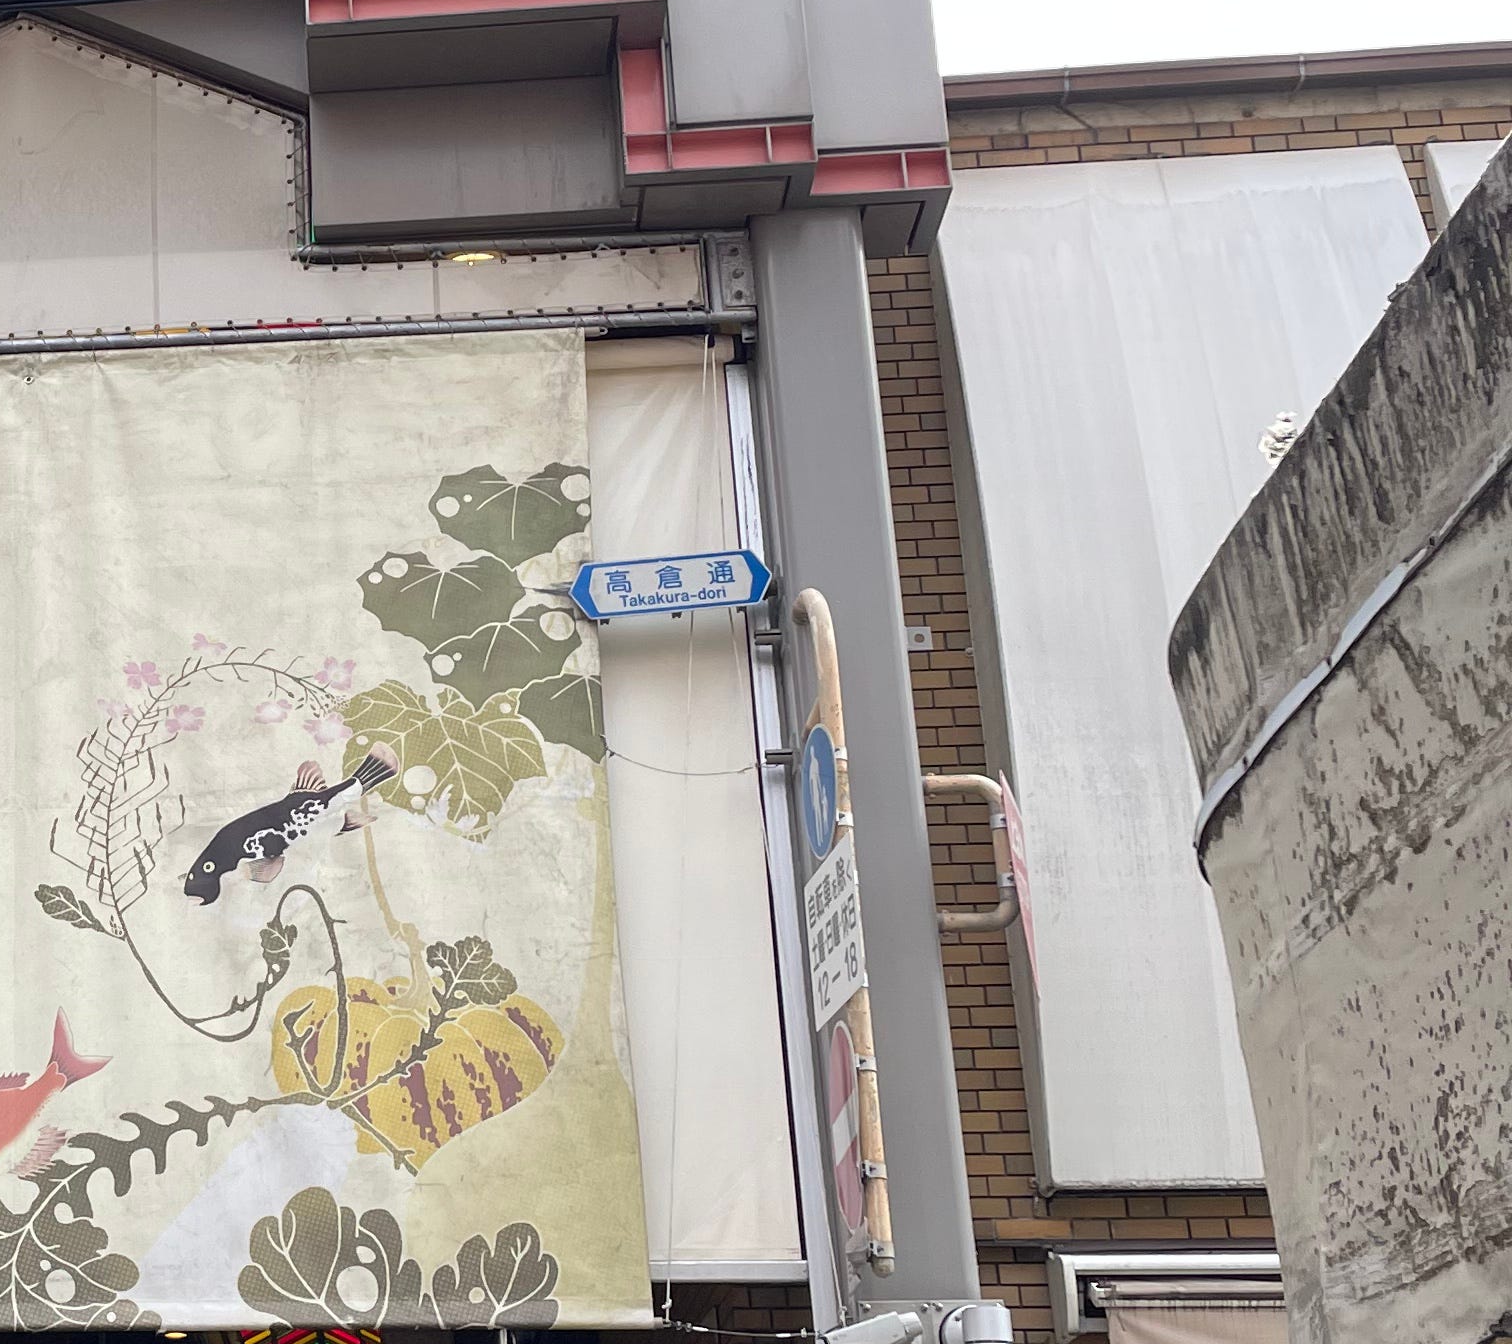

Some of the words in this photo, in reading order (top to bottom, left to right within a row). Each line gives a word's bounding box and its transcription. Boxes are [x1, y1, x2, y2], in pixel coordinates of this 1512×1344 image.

[604, 560, 736, 594] 高倉通
[620, 586, 727, 607] Takakura-dori
